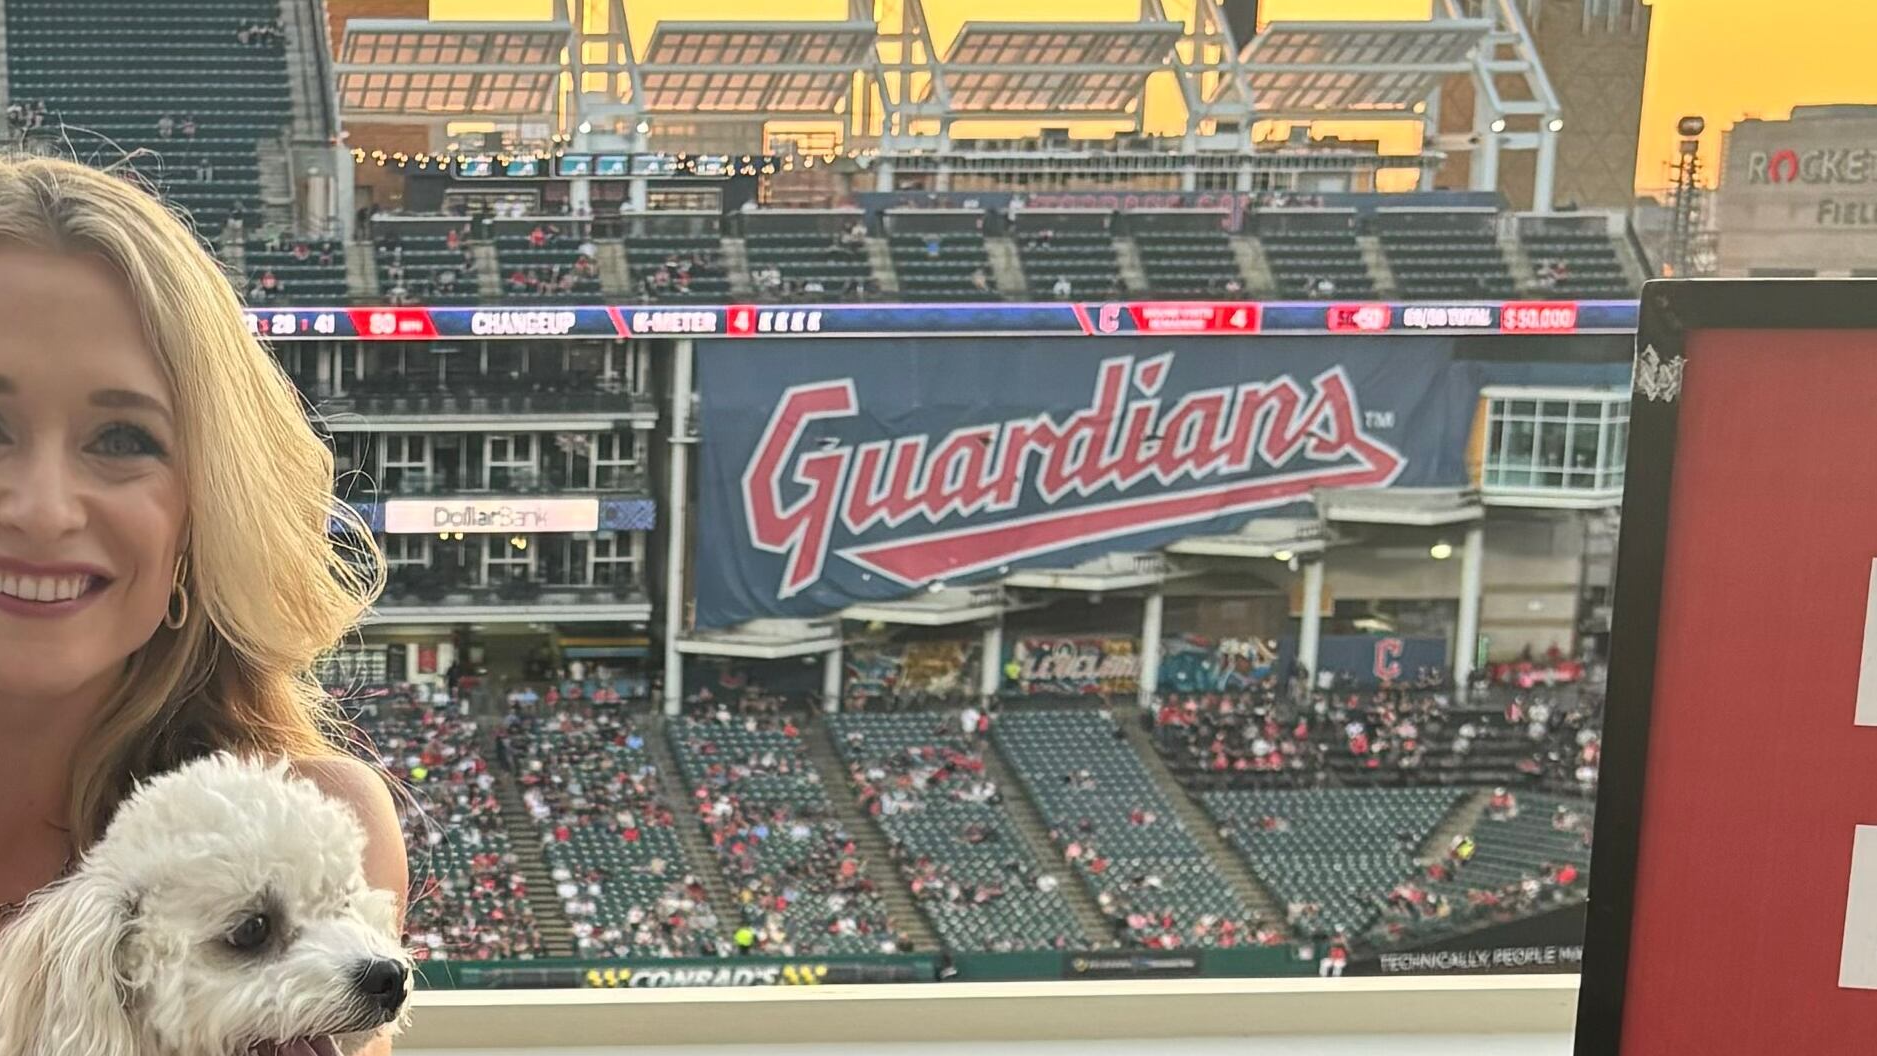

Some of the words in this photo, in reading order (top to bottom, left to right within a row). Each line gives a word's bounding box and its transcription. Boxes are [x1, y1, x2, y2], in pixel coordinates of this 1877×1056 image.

[1748, 149, 1877, 184] ROCKE
[1817, 200, 1877, 224] FIEL
[471, 312, 576, 335] CHANGEUP
[741, 350, 1364, 599] Guardians
[1493, 945, 1556, 967] PEOPLE
[628, 966, 780, 988] CONRAD'S
